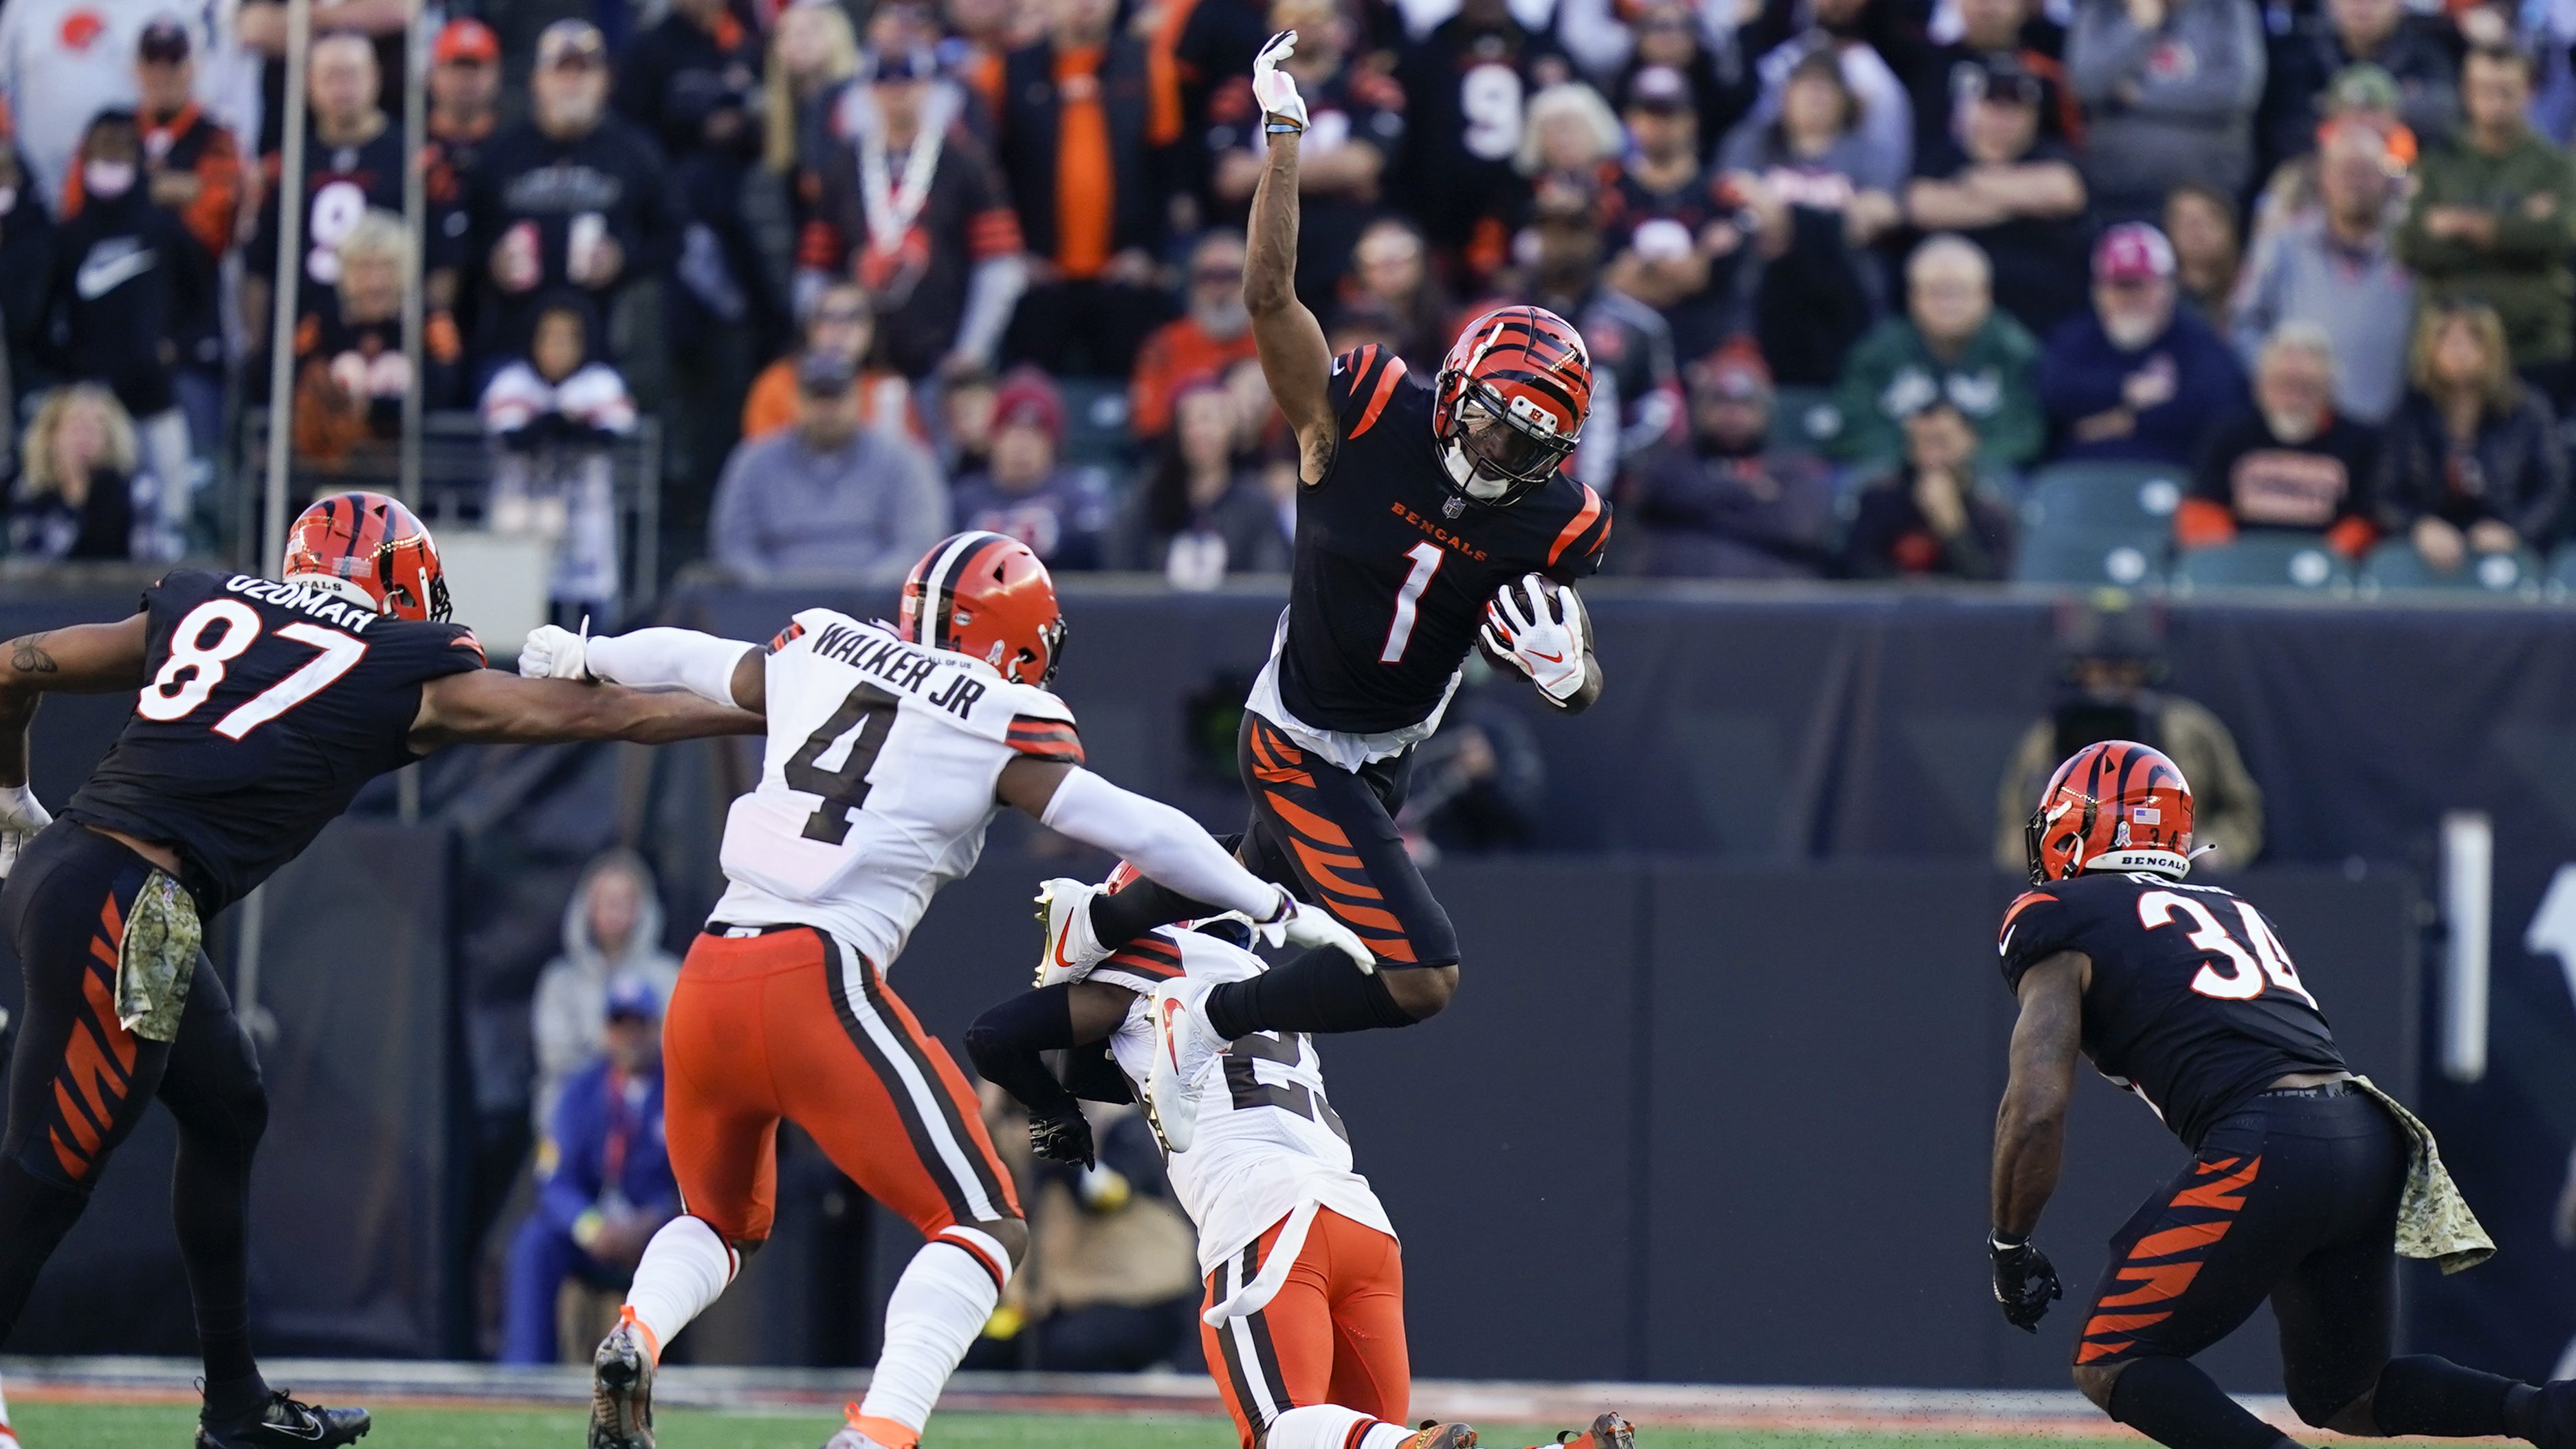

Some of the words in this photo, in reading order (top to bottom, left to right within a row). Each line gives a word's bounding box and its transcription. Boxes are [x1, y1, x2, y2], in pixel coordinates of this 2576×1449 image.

[1460, 65, 1521, 159] 9
[1391, 501, 1487, 561] BENGALS
[225, 574, 378, 633] UZOMAH
[1378, 540, 1445, 664] 1
[137, 596, 371, 743] 87
[812, 622, 938, 693] WALKER
[928, 674, 986, 720] JR
[783, 680, 903, 847] 4
[2122, 857, 2186, 871] BENGALS
[2136, 890, 2319, 1010] 34
